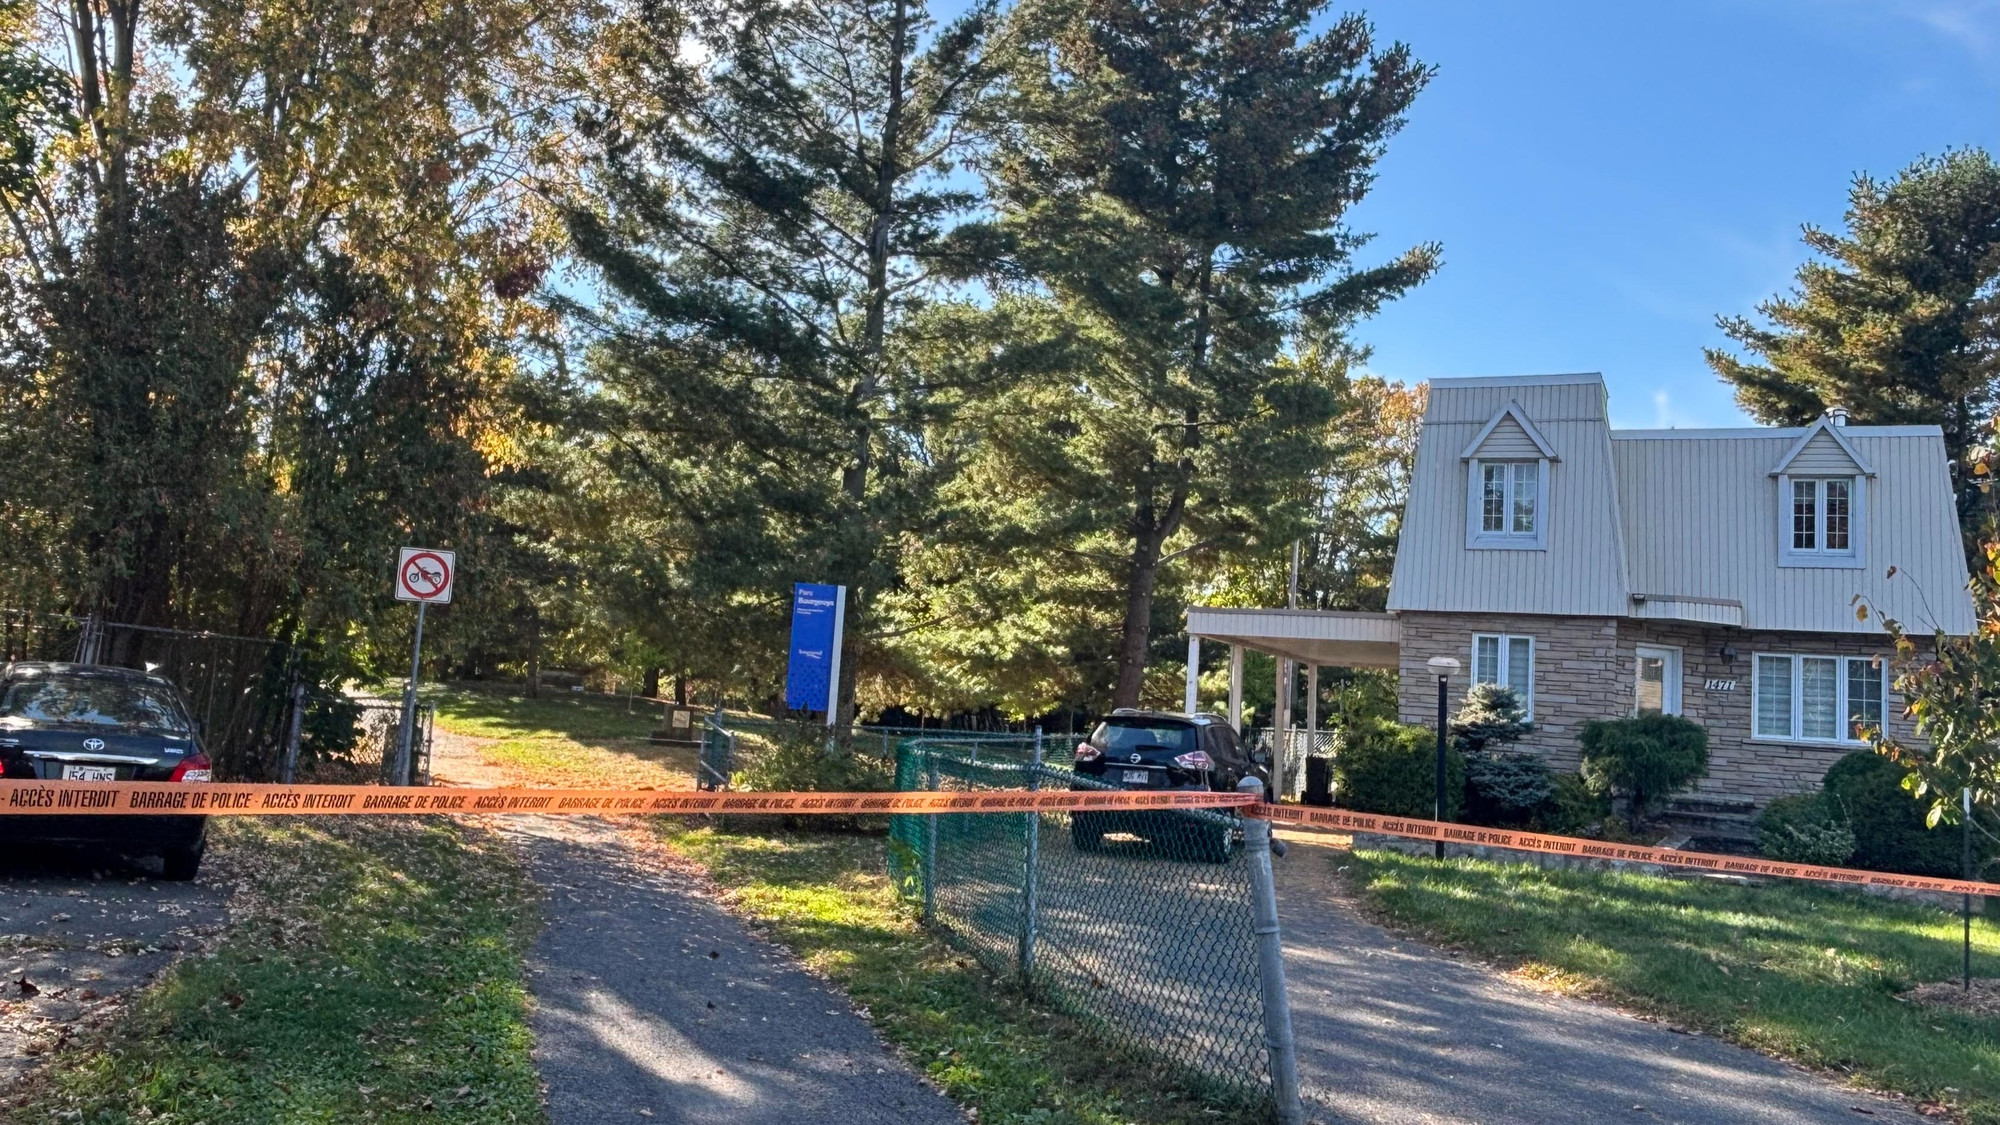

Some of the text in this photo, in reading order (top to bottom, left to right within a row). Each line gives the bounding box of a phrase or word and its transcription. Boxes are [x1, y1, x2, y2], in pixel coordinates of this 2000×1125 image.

[1709, 680, 1733, 690] 1471
[10, 785, 54, 808] ACCÈS
[57, 789, 120, 808] INTERDIT
[129, 791, 189, 808] BARRAGE
[190, 792, 206, 808] DE
[210, 792, 253, 809] POLICE
[261, 789, 300, 808] ACCÈS
[302, 794, 356, 809] INTERDIT
[362, 794, 414, 809] BARRAGE
[414, 795, 428, 809] DE
[430, 795, 468, 809] POLICE
[474, 793, 508, 809] ACCÈS
[508, 796, 554, 808] INTERDIT
[558, 797, 602, 809] BARRAGE
[614, 798, 647, 809] POLICE
[1310, 812, 1340, 825] BARRAGE
[1342, 815, 1350, 826] DE
[1352, 817, 1376, 829] POLICE
[1382, 820, 1404, 832] ACCÈS
[1406, 823, 1438, 836] INTERDIT
[1444, 828, 1475, 841] BARRAGE
[1477, 832, 1487, 842] DE
[1488, 834, 1512, 846] POLICE
[1518, 836, 1542, 848] ACCÈS
[1543, 839, 1576, 852] INTERDIT
[1582, 844, 1615, 857] BARRAGE
[1628, 849, 1652, 861] POLICE
